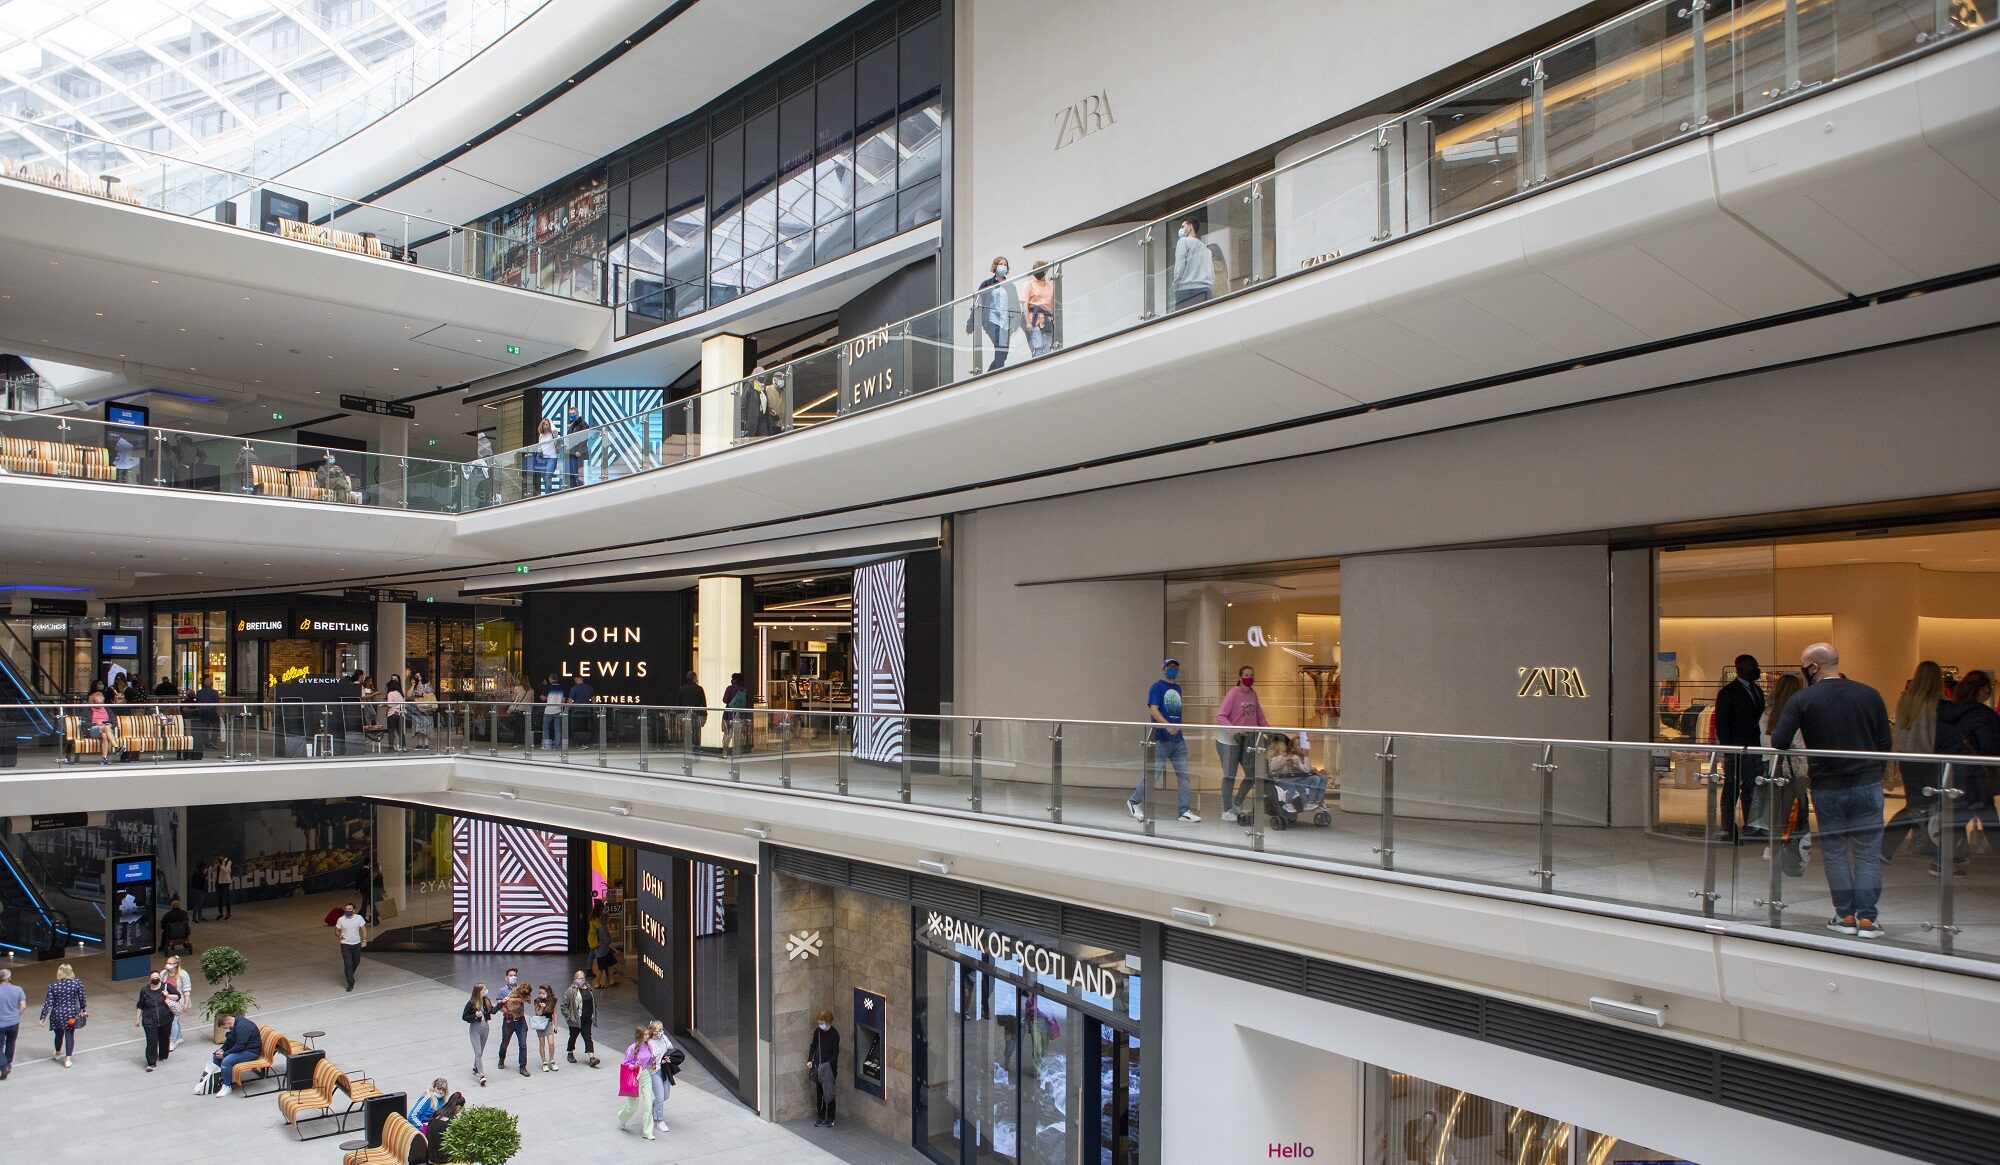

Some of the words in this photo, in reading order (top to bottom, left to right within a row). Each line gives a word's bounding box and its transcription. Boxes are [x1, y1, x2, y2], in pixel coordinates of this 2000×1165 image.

[1053, 89, 1119, 151] ZARA
[849, 323, 889, 366] JOHN
[849, 368, 892, 407] EWIS
[246, 621, 283, 631] BREITLING
[314, 621, 369, 632] BREITLING
[568, 627, 641, 646] JOHN
[562, 661, 647, 678] LEWIS
[1518, 666, 1591, 697] ZARA
[589, 695, 641, 703] RTNERS
[642, 870, 664, 901] JOHN
[641, 910, 666, 947] LEWIS
[945, 916, 986, 953] BANK
[988, 932, 1011, 961] OF
[1016, 941, 1117, 998] SCOTLAND
[1268, 1142, 1315, 1158] Hello
